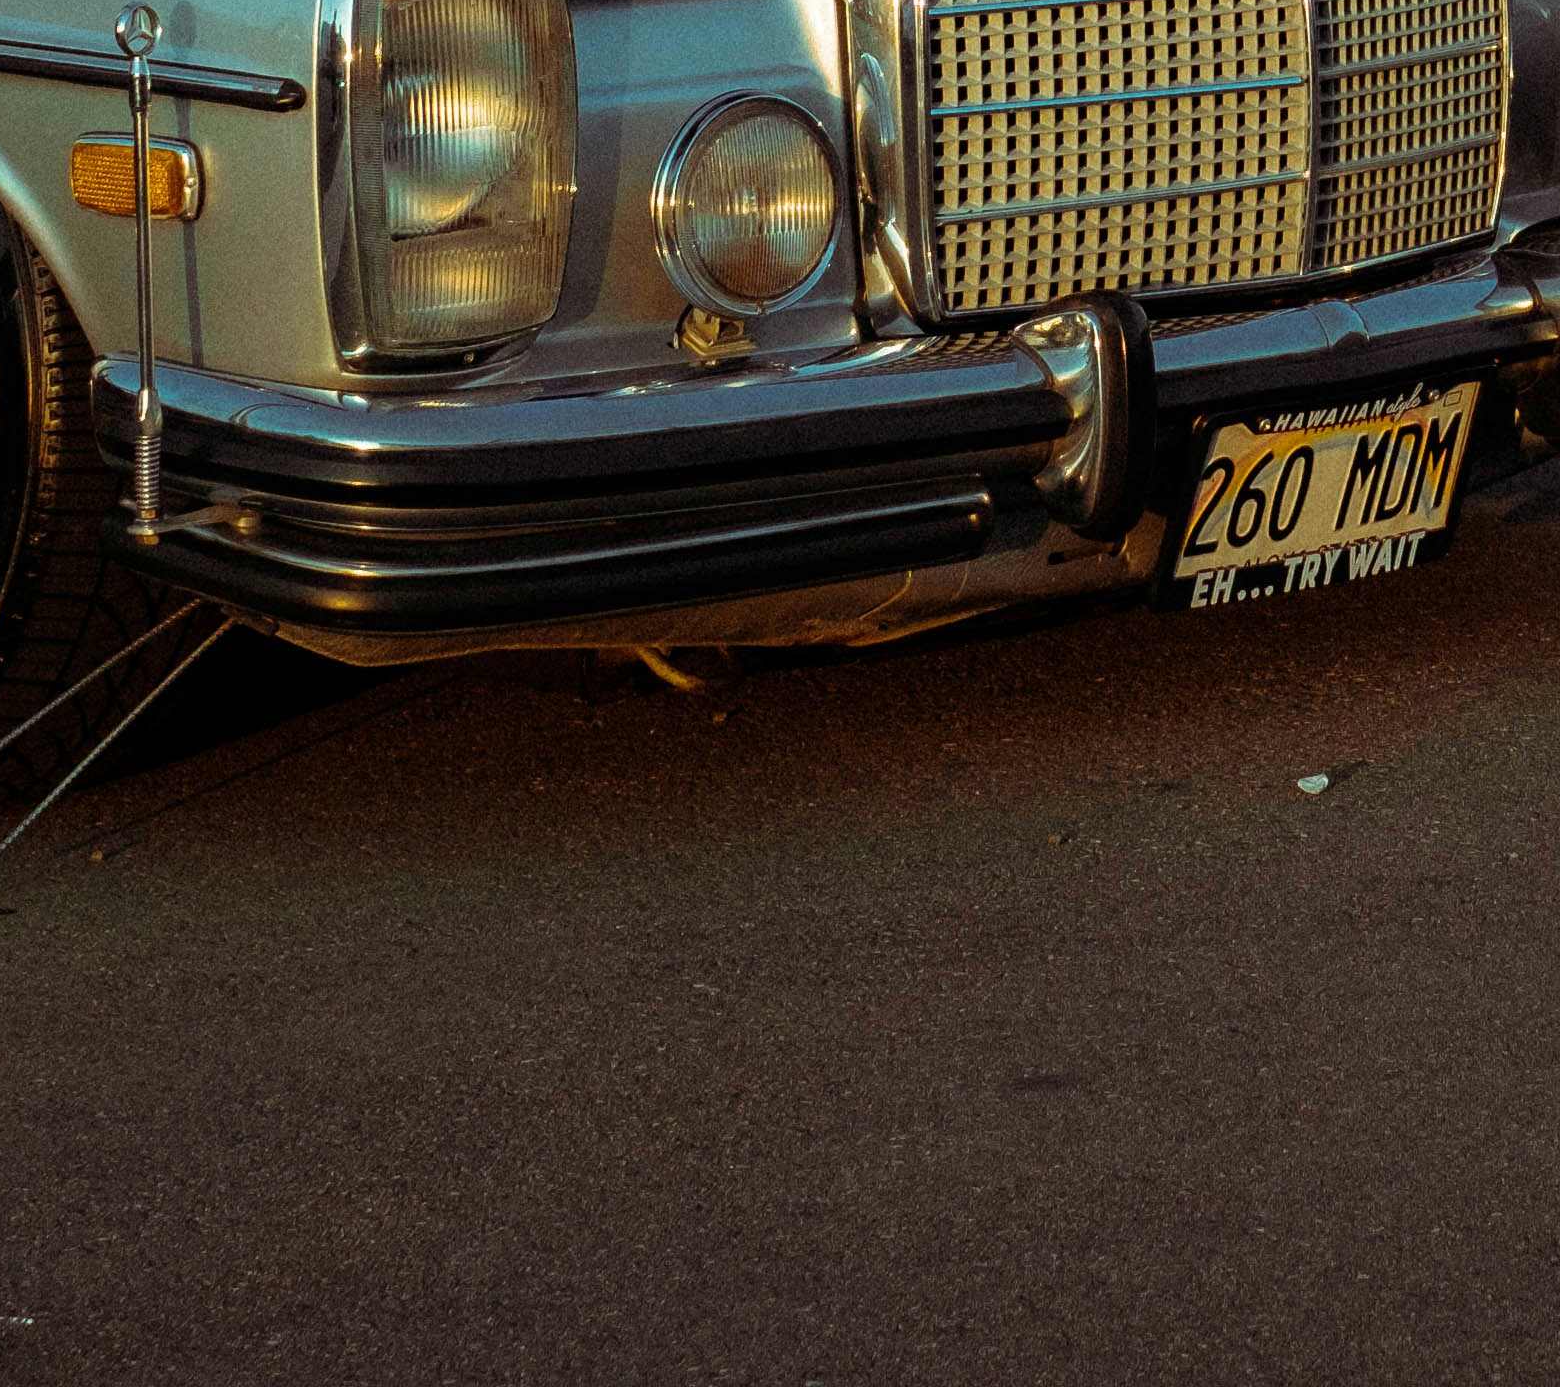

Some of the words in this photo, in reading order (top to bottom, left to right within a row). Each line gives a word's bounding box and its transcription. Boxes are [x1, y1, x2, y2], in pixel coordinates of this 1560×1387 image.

[1273, 397, 1387, 432] HAWAIIAN
[1385, 381, 1424, 423] style
[1183, 444, 1315, 559] 260
[1333, 409, 1462, 532] MDM
[1190, 567, 1274, 609] EH...
[1283, 548, 1343, 593] TRY
[1348, 530, 1427, 580] WAIT
